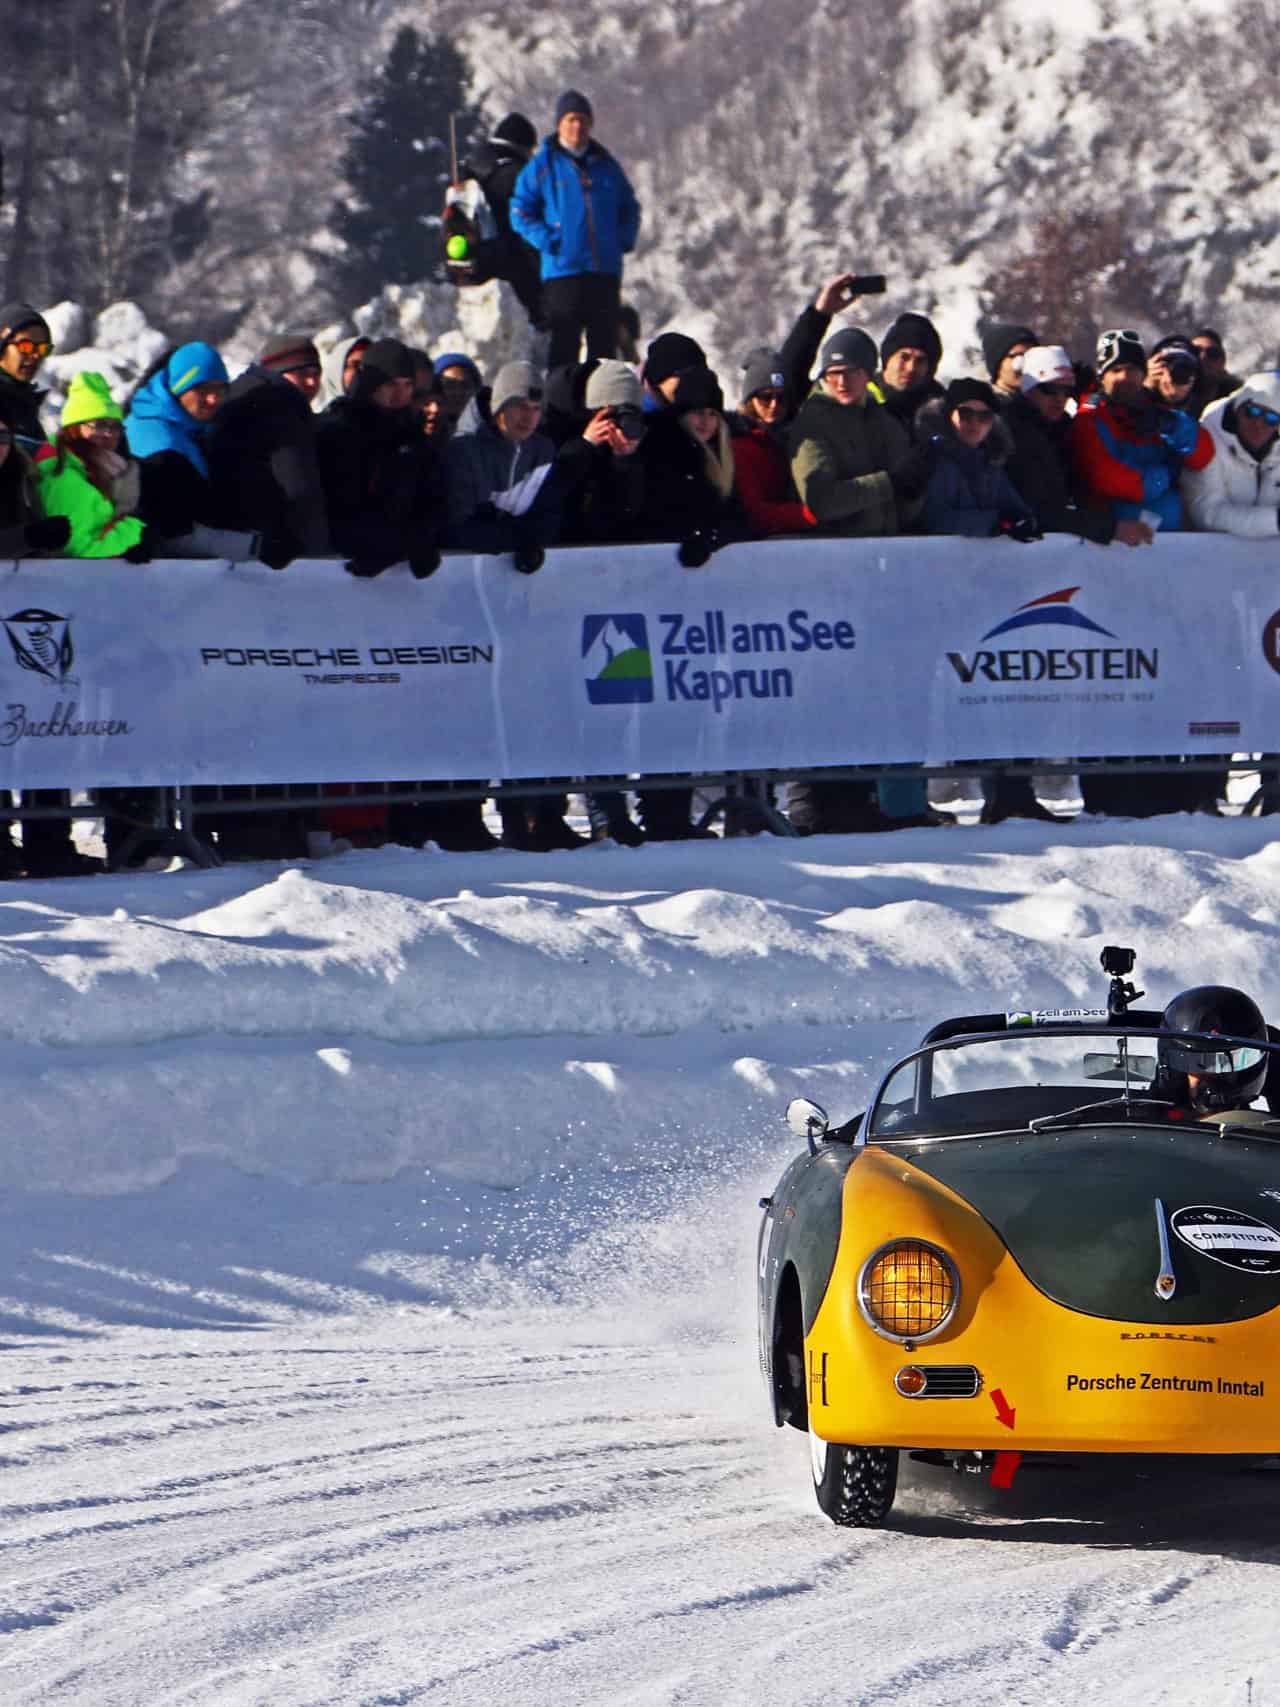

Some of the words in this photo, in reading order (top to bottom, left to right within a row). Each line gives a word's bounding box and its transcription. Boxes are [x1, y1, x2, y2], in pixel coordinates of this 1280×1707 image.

[659, 611, 726, 655] Zell
[731, 622, 787, 652] am
[788, 609, 856, 651] See
[200, 648, 361, 667] PORSCHE
[370, 645, 494, 665] DESIGN
[945, 648, 1159, 683] VREDESTEIN
[664, 659, 793, 713] Kaprun
[1192, 1232, 1279, 1243] COMPETITOR
[1066, 1373, 1136, 1391] Porsche
[1140, 1373, 1213, 1393] Zentrum
[1217, 1377, 1265, 1397] Inntal
